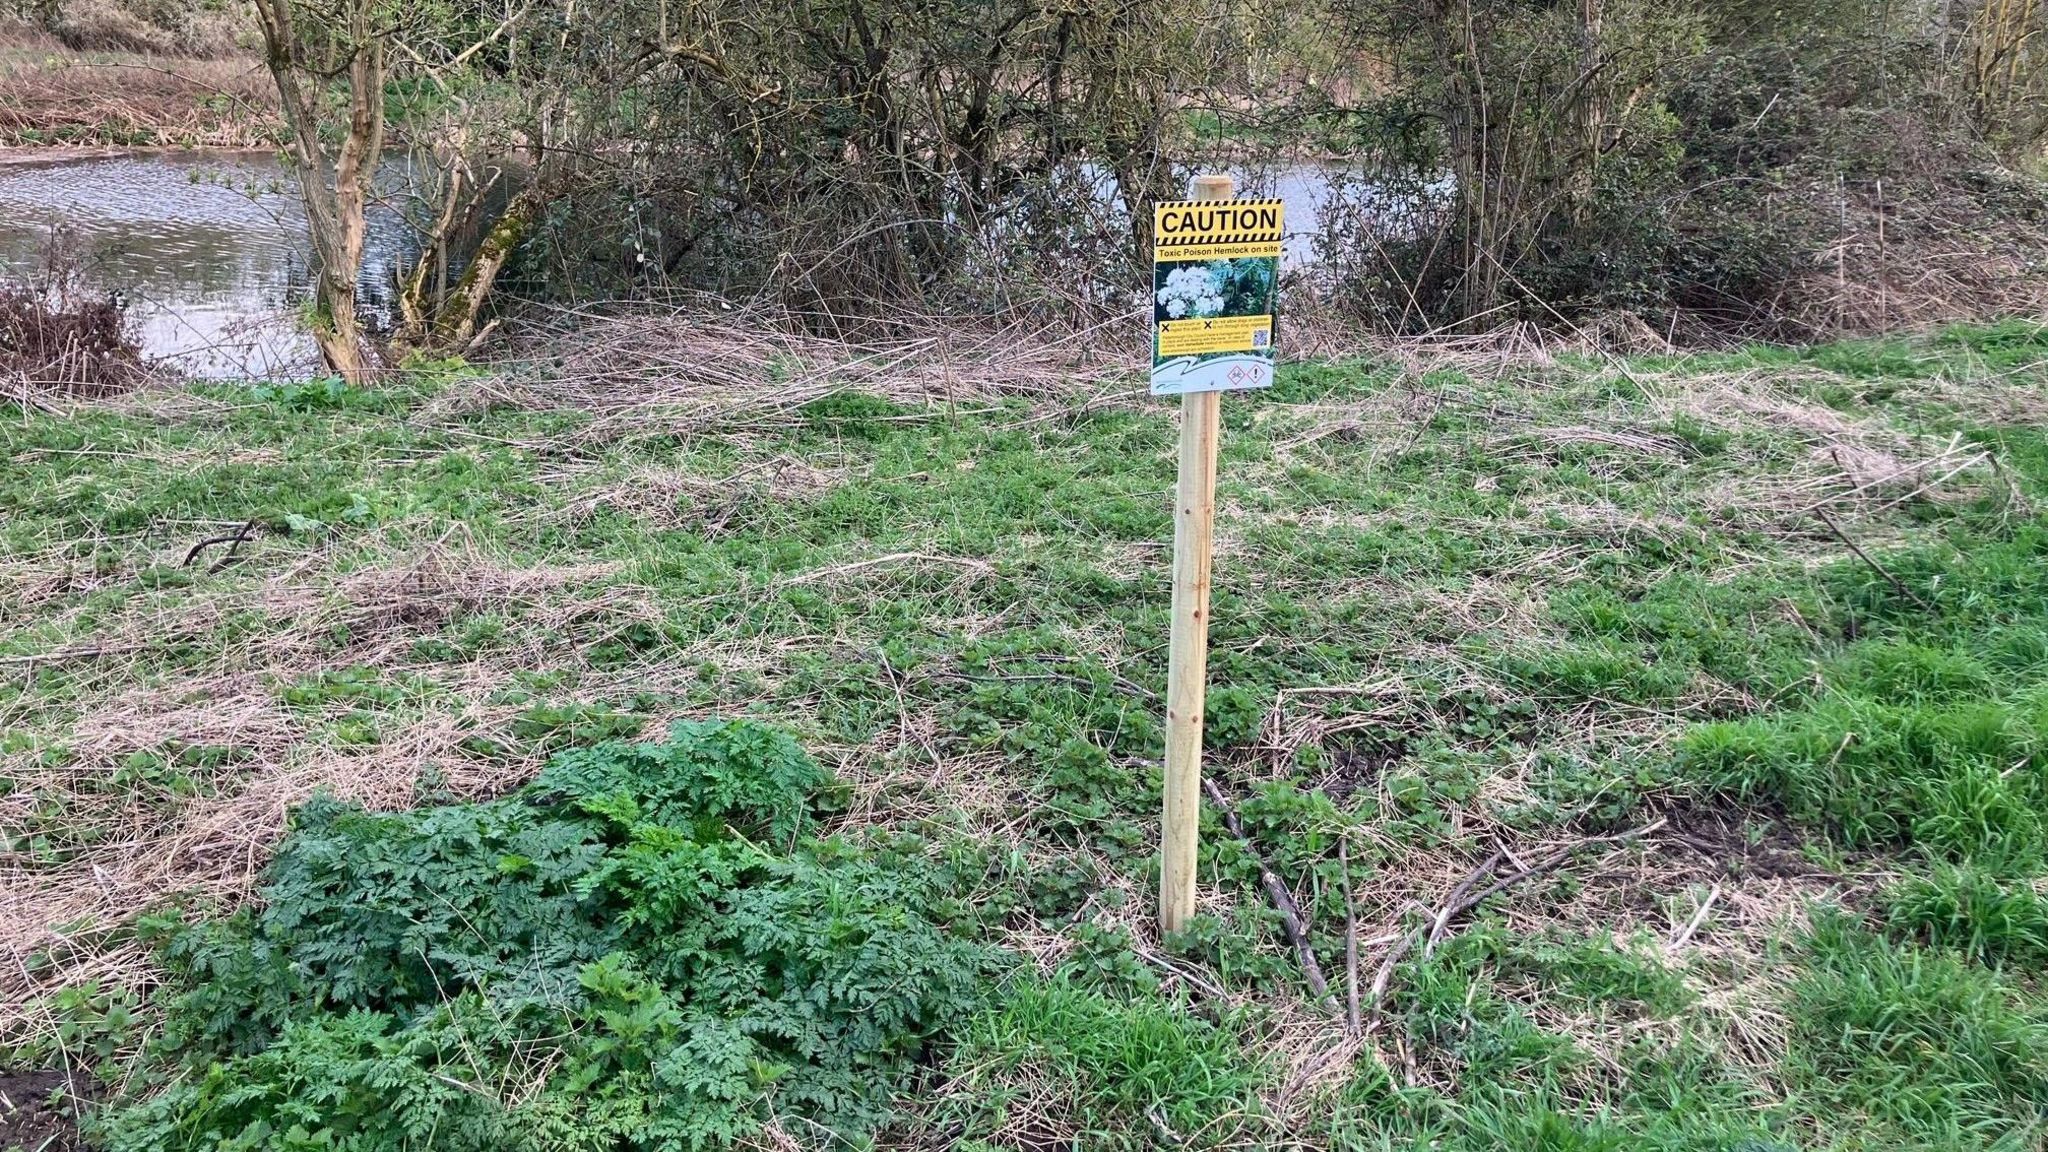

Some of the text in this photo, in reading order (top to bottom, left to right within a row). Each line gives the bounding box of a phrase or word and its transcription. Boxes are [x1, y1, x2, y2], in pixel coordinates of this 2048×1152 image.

[1161, 208, 1277, 233] CAUTION
[1160, 249, 1181, 257] Toxic
[1183, 248, 1212, 256] Poison
[1214, 246, 1248, 255] Hemlock
[1263, 245, 1278, 253] site
